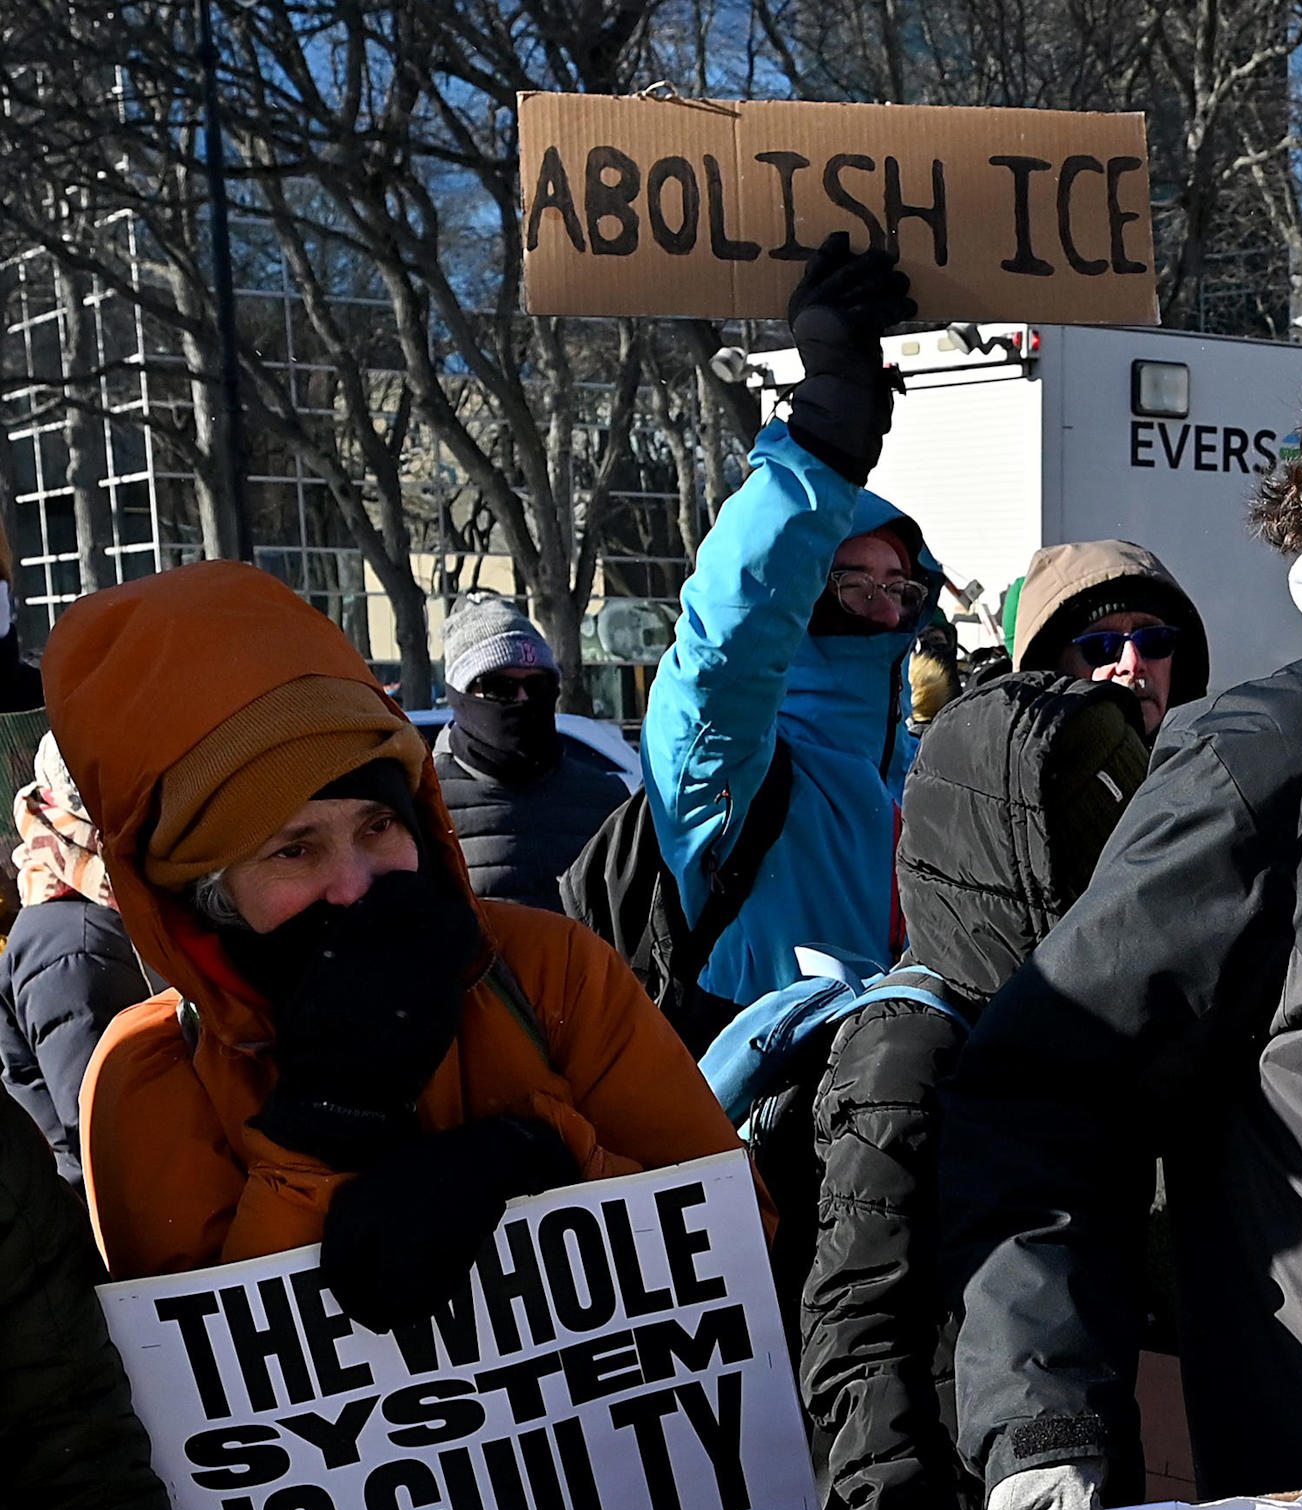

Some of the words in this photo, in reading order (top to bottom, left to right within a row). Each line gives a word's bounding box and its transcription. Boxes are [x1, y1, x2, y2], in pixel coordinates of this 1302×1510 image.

[524, 145, 948, 268] ABOLISH
[989, 154, 1148, 277] ICE
[154, 1267, 376, 1420] THE
[183, 1305, 753, 1491] SYSTEM
